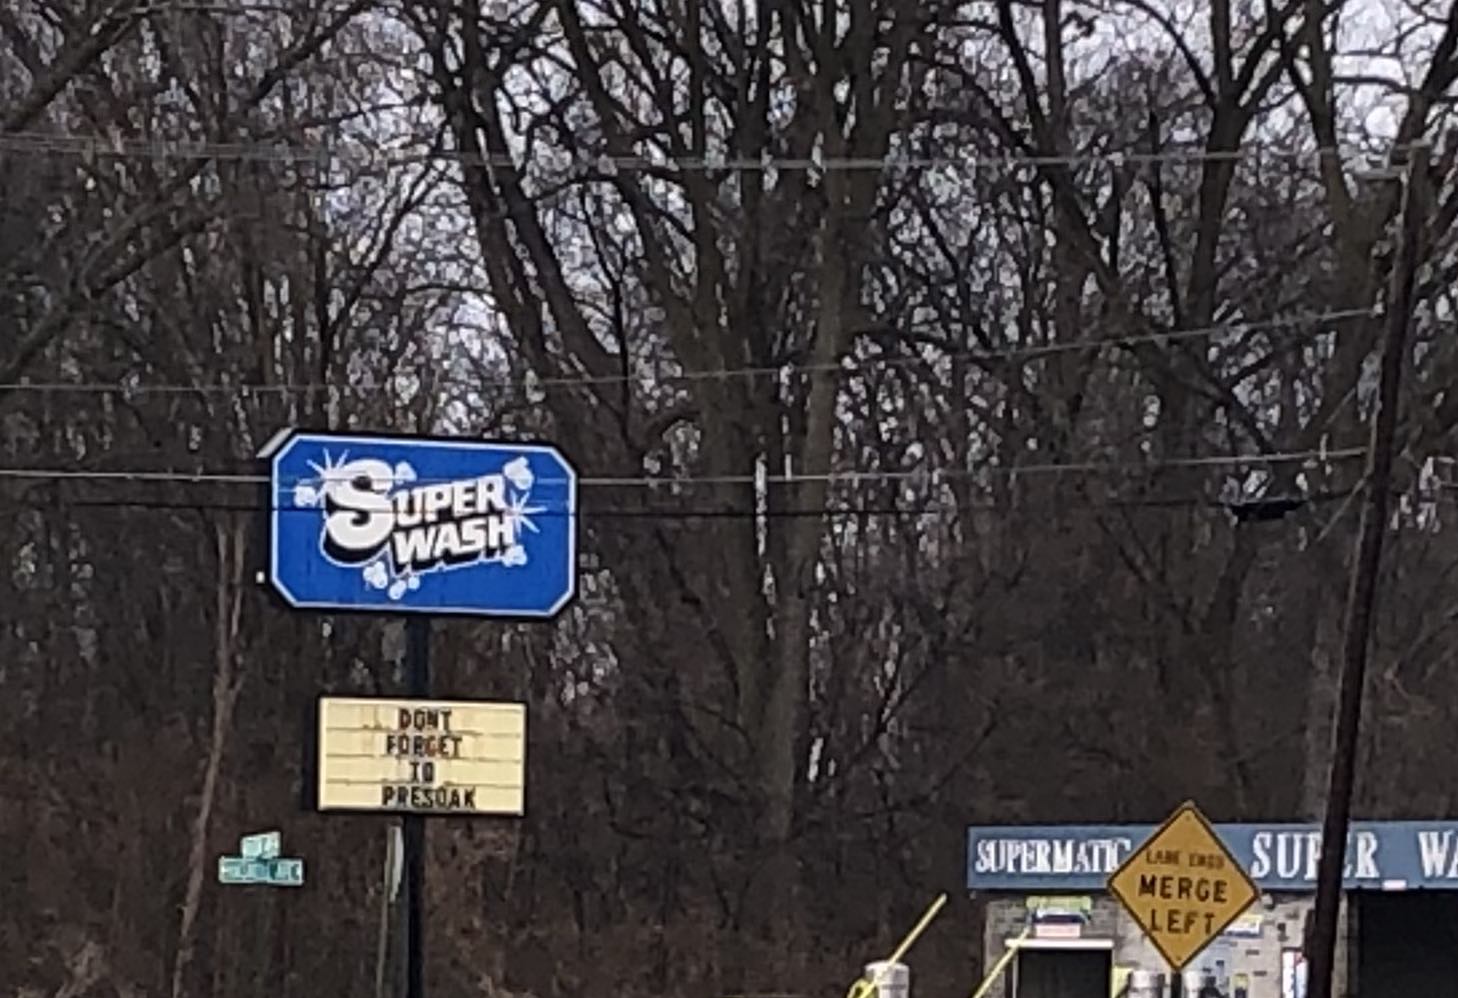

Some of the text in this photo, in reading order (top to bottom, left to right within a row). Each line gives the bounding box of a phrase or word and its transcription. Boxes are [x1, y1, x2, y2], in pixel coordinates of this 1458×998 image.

[321, 457, 511, 552] SUPER
[393, 513, 516, 570] WASH
[399, 709, 452, 731] DONT
[386, 735, 463, 758] FORGET
[381, 786, 477, 809] PRESOAK
[1251, 830, 1379, 880] SUPR
[1138, 874, 1228, 903] MERGE
[1151, 908, 1215, 935] LEFT
